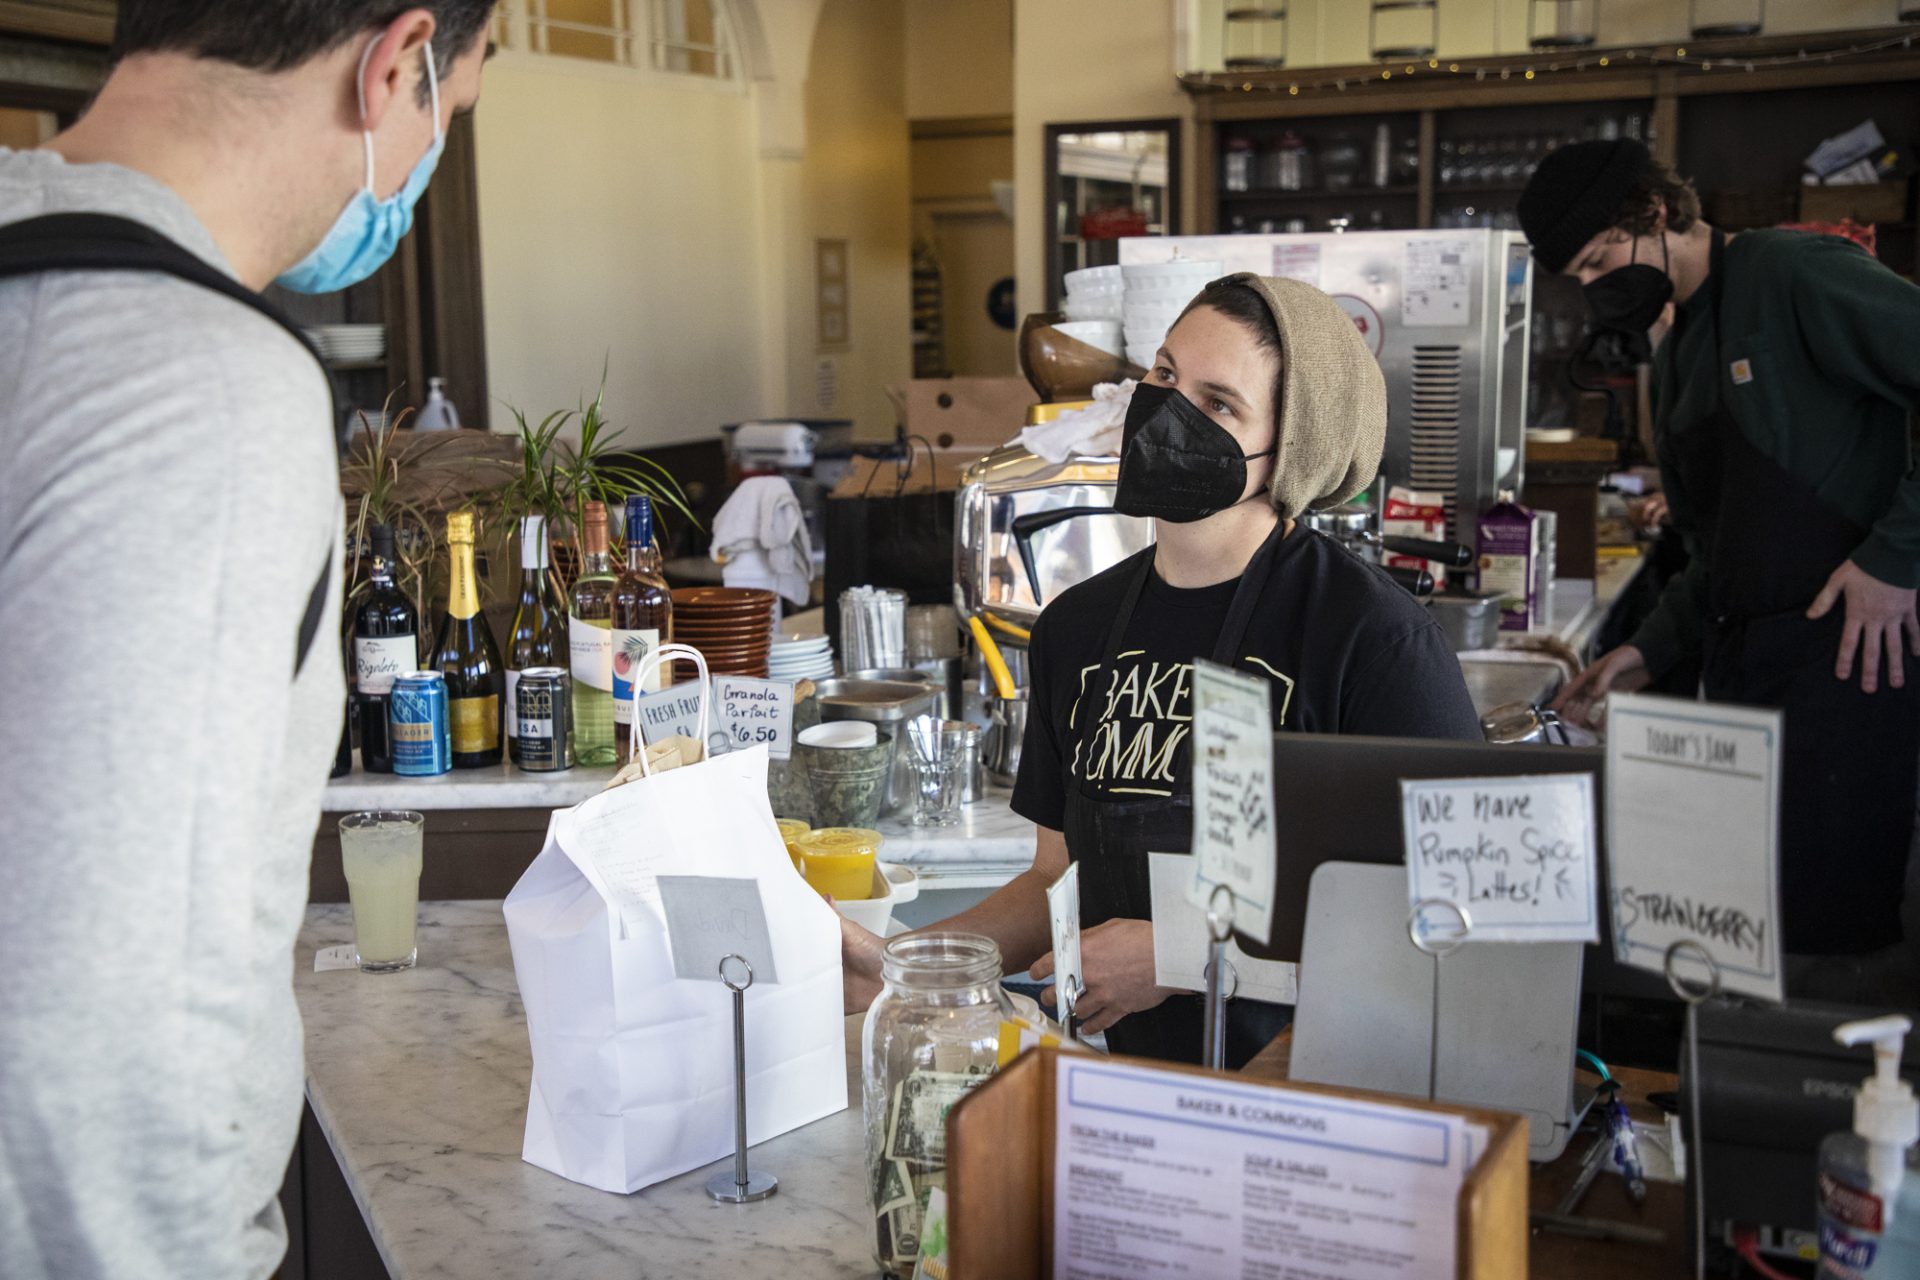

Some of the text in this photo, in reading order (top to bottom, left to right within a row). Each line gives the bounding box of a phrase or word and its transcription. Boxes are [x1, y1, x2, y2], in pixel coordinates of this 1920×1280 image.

[724, 684, 779, 701] Granola
[645, 703, 677, 725] FRESH
[726, 703, 779, 719] Parfait
[730, 722, 777, 742] $6.50
[1646, 726, 1737, 766] TODAY'S JAM
[1419, 791, 1533, 823] We have
[1418, 827, 1581, 873] Pumpkin Spice
[1621, 886, 1766, 967] STRAWBERRY
[1176, 1095, 1326, 1133] BAKER & COMMONS
